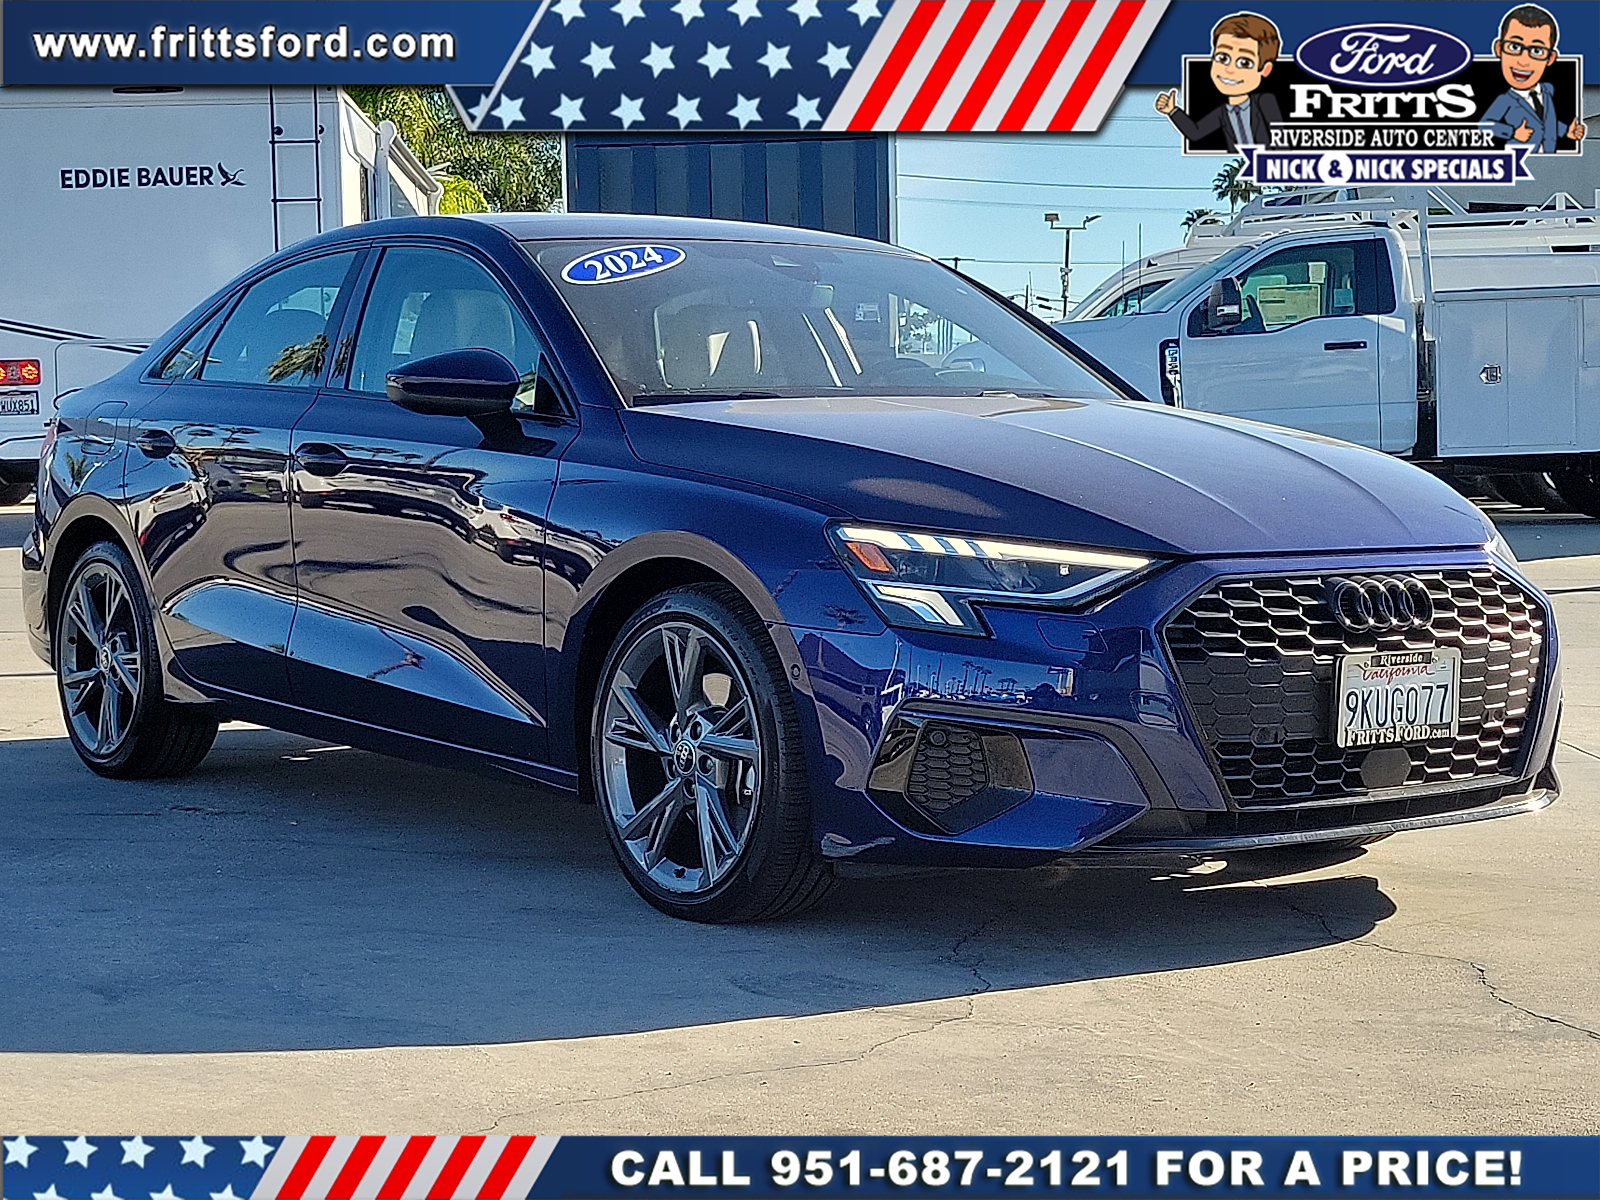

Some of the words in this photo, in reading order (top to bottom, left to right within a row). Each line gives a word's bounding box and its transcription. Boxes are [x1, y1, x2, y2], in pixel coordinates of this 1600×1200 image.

[60, 168, 131, 188] EDDIE
[137, 166, 214, 187] BAUER
[584, 246, 664, 281] 2024
[1380, 653, 1423, 665] Riverside
[1362, 665, 1435, 685] California
[1346, 684, 1448, 730] 9KUG077
